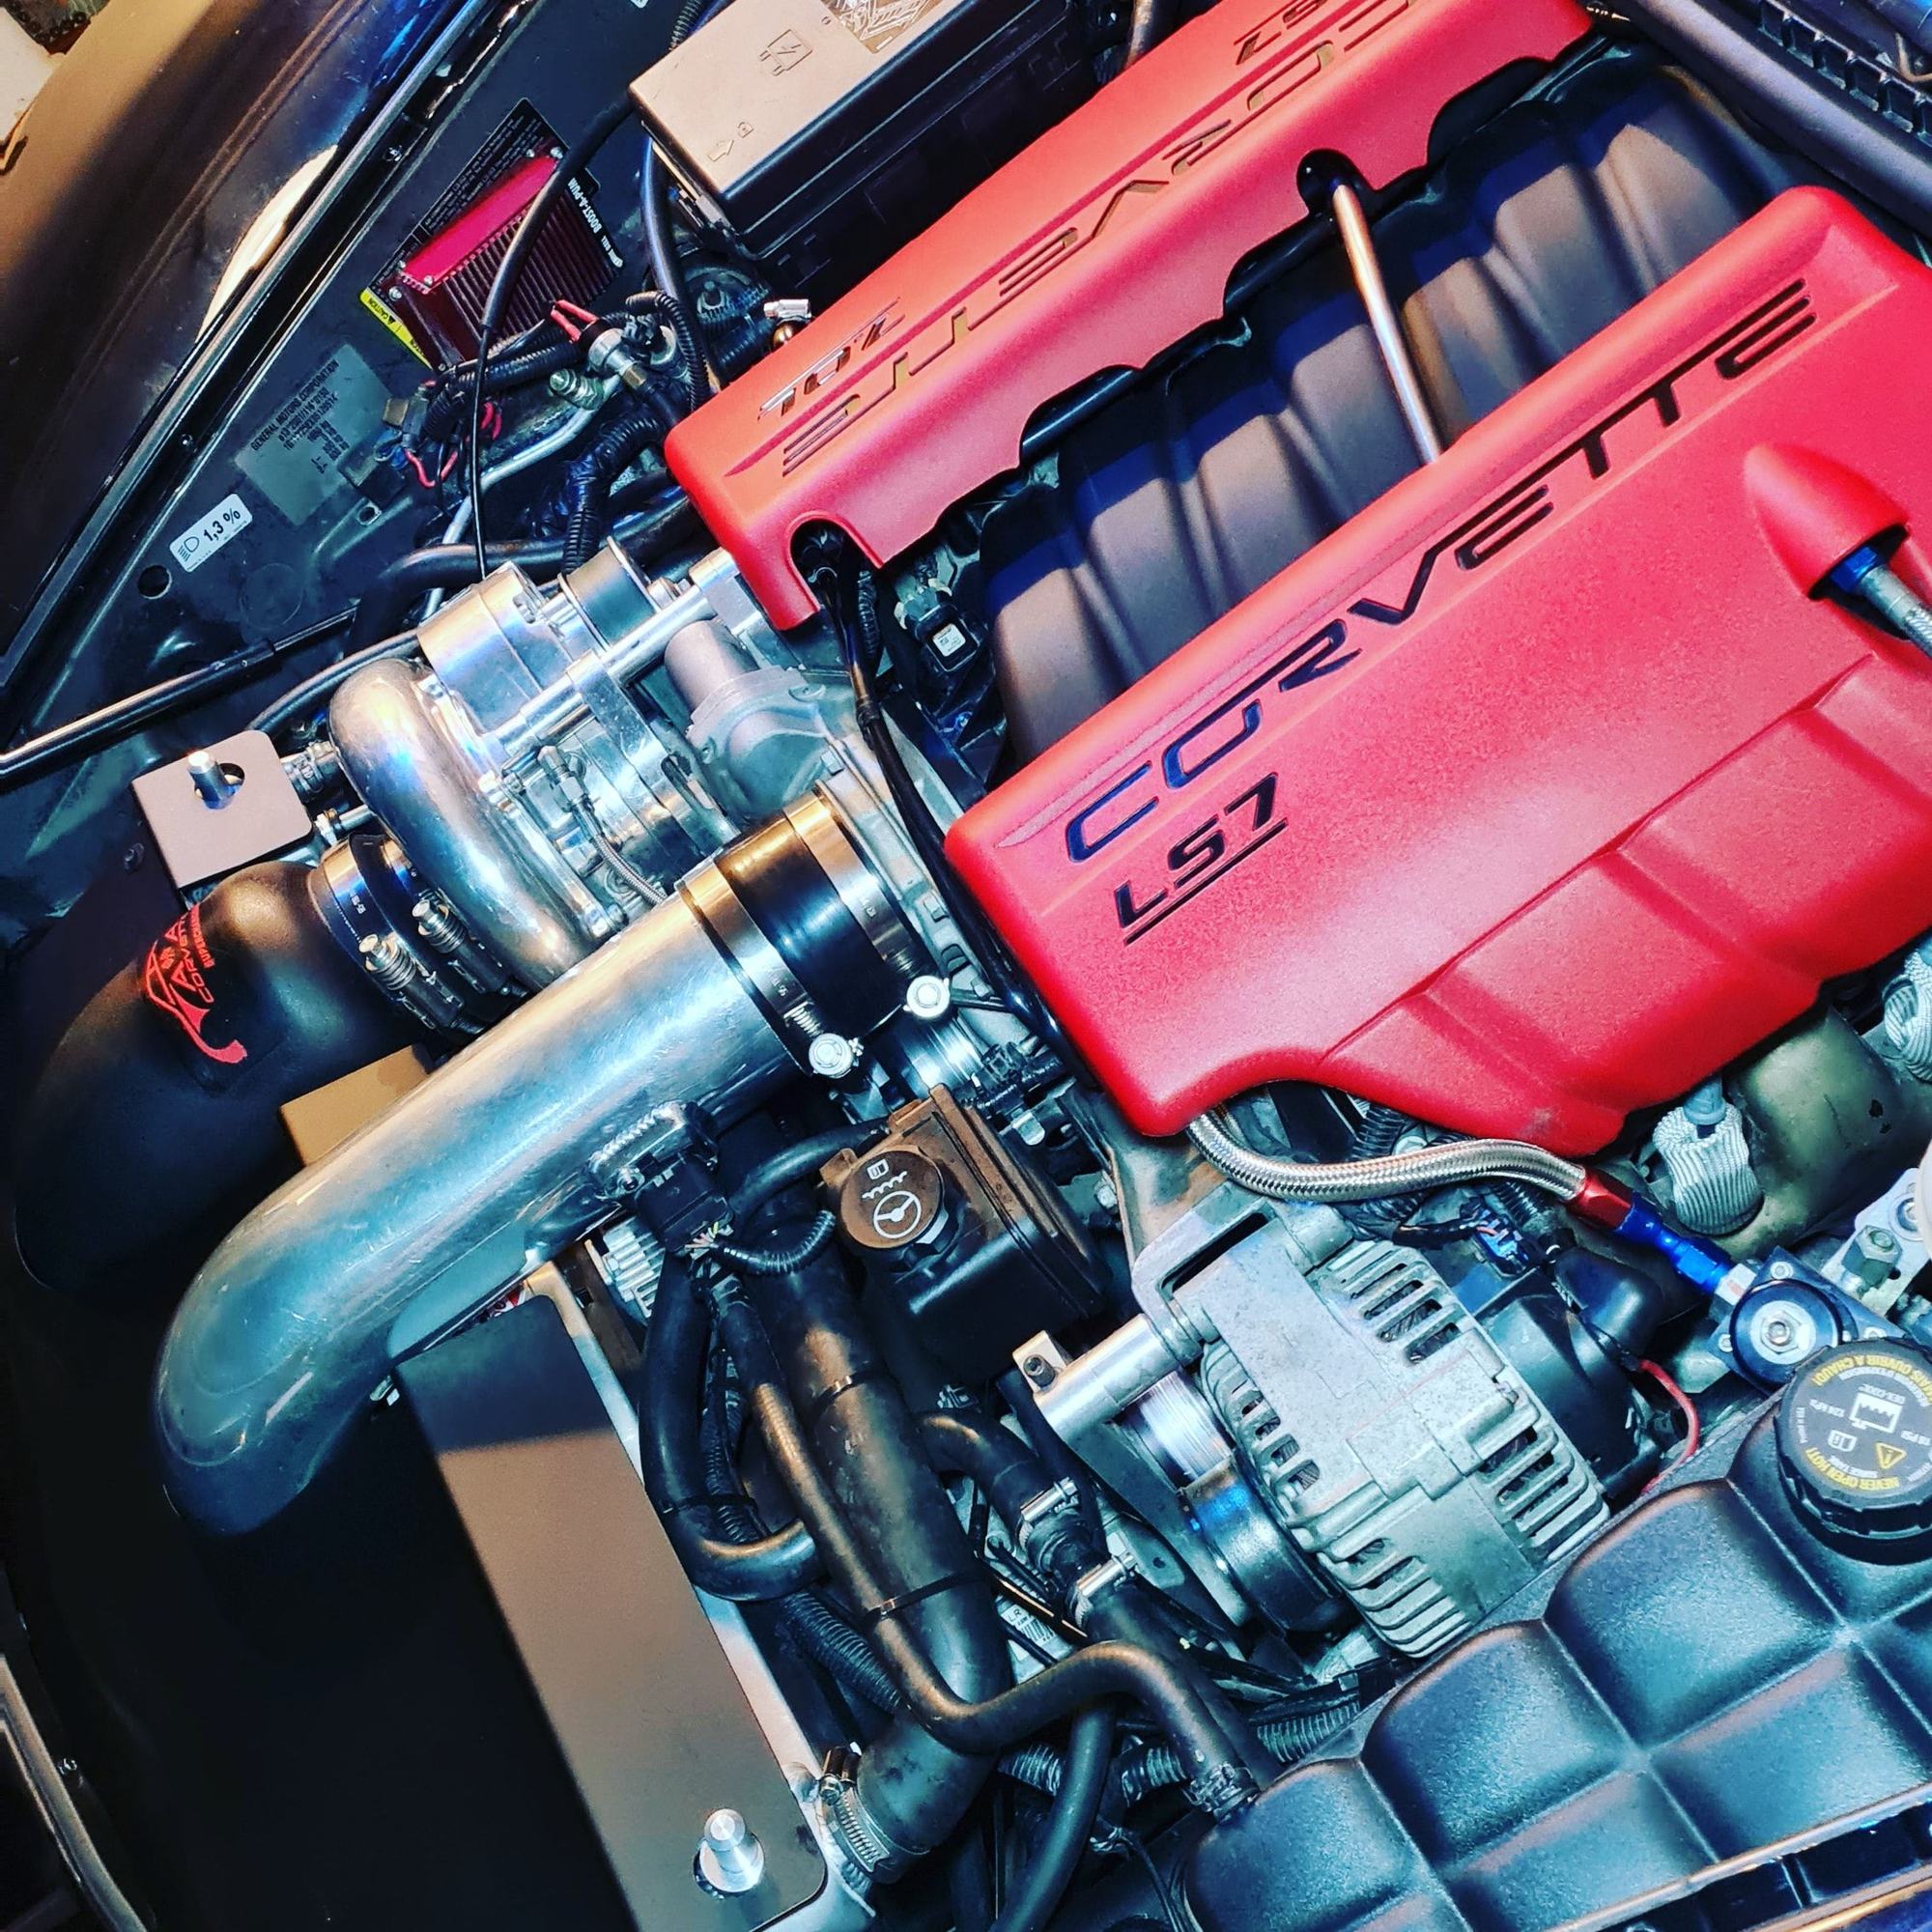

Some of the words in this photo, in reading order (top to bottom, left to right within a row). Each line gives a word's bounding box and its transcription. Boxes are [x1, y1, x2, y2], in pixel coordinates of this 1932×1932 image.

[1236, 0, 1328, 65] S7
[568, 177, 603, 234] BOOST-A-PUM
[782, 0, 1418, 477] CORVETTE
[251, 423, 278, 451] GENERAL
[275, 398, 302, 425] MOTORS
[298, 358, 339, 402] CORPORATION
[204, 520, 224, 542] 1,3
[222, 507, 241, 525] %
[1065, 277, 1817, 863] CORVETTE
[1114, 772, 1278, 928] LS7
[178, 912, 214, 1003] CORVETT
[1804, 1446, 1831, 1472] HOT!
[1826, 1465, 1860, 1489] OPEN
[1859, 1475, 1901, 1491] NEVER
